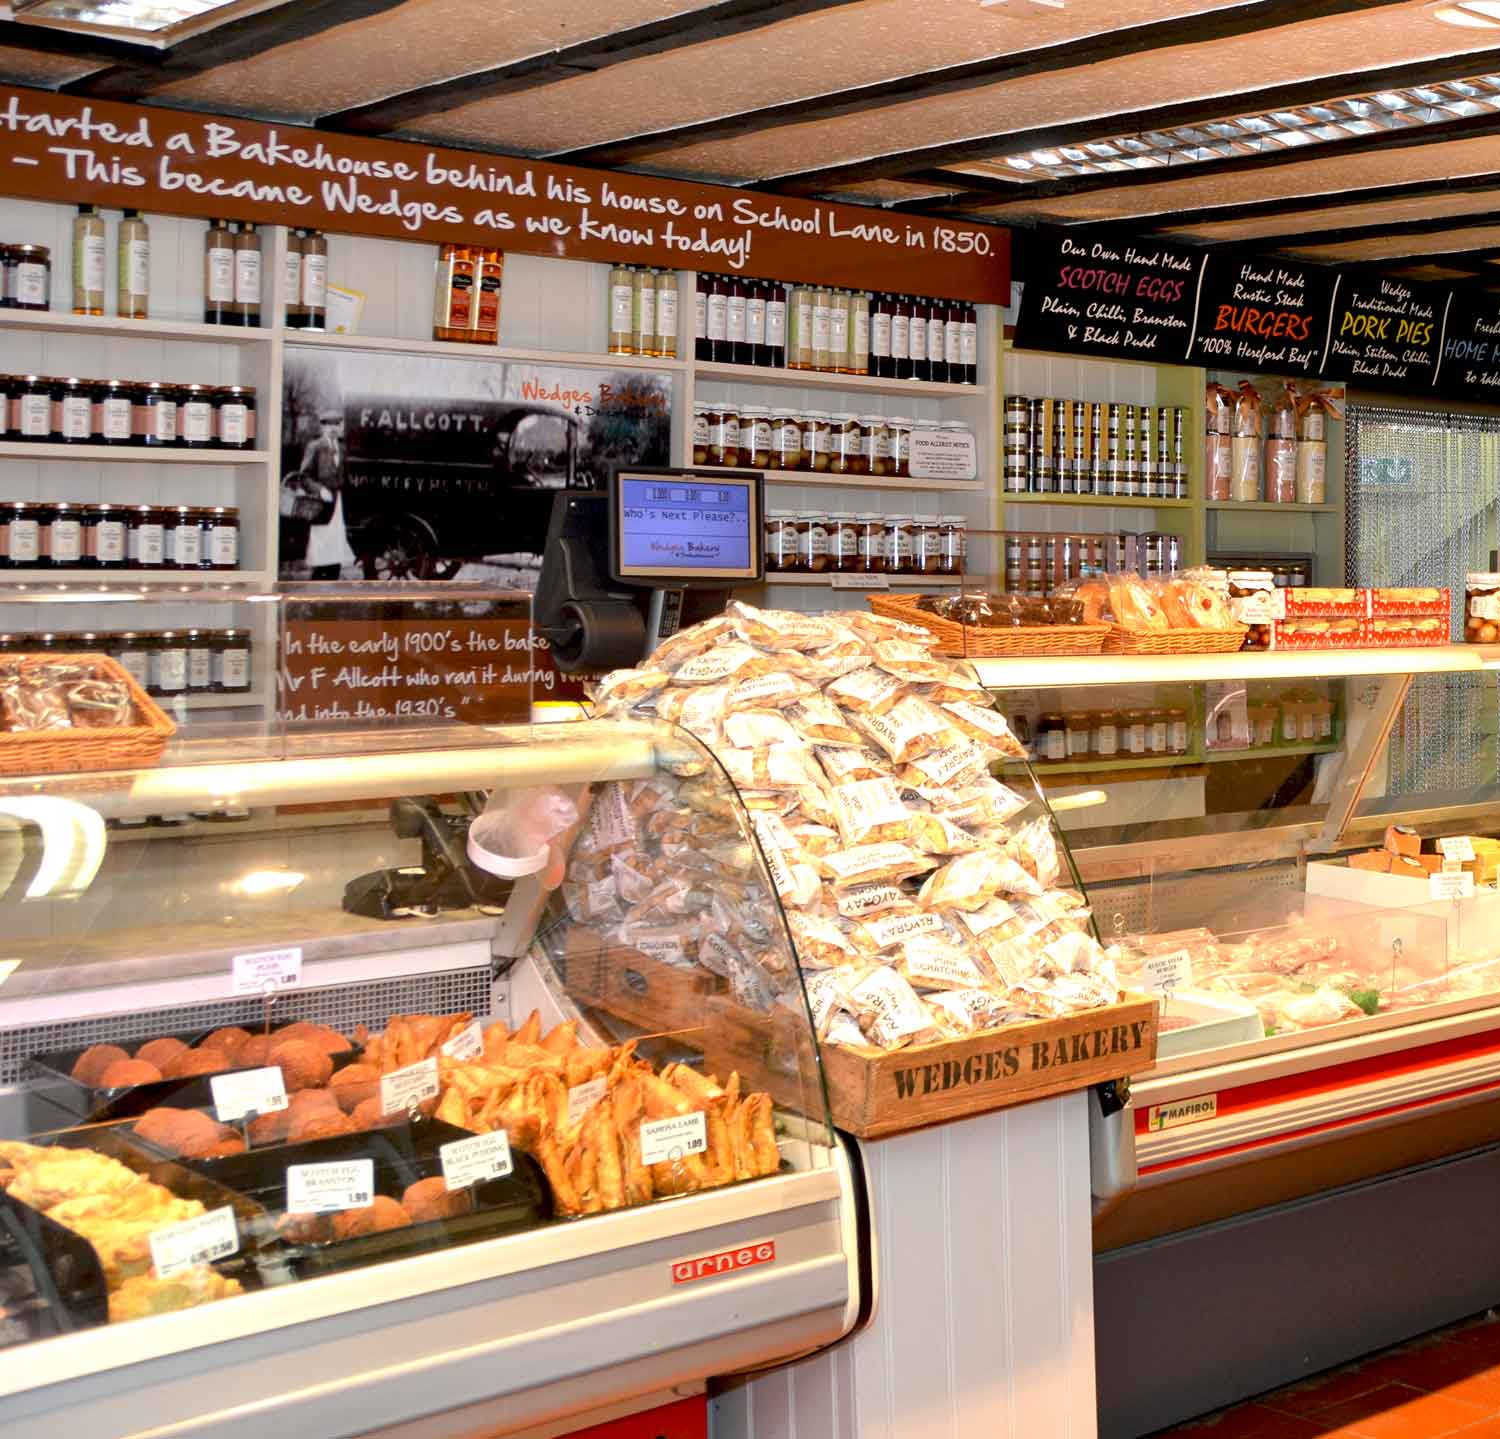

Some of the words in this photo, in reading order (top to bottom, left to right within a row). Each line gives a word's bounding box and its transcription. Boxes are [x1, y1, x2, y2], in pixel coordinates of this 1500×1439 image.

[0, 97, 153, 148] tarted
[167, 132, 194, 153] a
[204, 123, 418, 181] Bakehouse
[426, 154, 536, 197] behind
[547, 176, 591, 205] his
[601, 181, 687, 216] house
[694, 204, 723, 221] on
[733, 200, 821, 236] School
[828, 213, 900, 244] Lane
[906, 226, 925, 249] in
[932, 228, 995, 257] 1850.
[48, 147, 145, 188] This
[159, 156, 312, 206] became
[320, 174, 464, 231] Wedges
[474, 208, 516, 231] as
[526, 214, 570, 236] we
[580, 208, 654, 247] know
[660, 223, 753, 269] today!
[1061, 239, 1086, 256] Our
[1092, 244, 1119, 261] Own
[1124, 248, 1158, 266] Hand
[1161, 252, 1192, 271] Made
[1057, 266, 1130, 297] SCOTCH
[1136, 276, 1185, 304] EGGS
[1240, 264, 1274, 283] Hand
[1277, 269, 1305, 289] Made
[1233, 283, 1271, 304] Rustic
[1276, 290, 1304, 308] Steak
[1381, 280, 1411, 302] Wedges
[1133, 307, 1187, 328] Branston
[1352, 294, 1405, 315] Traditional
[1409, 302, 1432, 319] Made
[1215, 305, 1312, 342] BURGERS
[1340, 311, 1391, 341] PORK
[1396, 318, 1434, 346] PIES
[1084, 326, 1119, 345] Black
[1124, 330, 1157, 349] Pudd
[1444, 338, 1489, 362] HOME
[1237, 341, 1284, 366] Hereford
[1352, 360, 1379, 376] Black
[1383, 362, 1406, 378] Pudd
[522, 376, 592, 410] Wedges
[662, 510, 686, 521] Next
[286, 632, 302, 655] In
[307, 632, 345, 656] the
[349, 631, 399, 661] early
[404, 629, 461, 654] 1900's
[466, 630, 502, 652] the
[309, 667, 327, 690] F
[333, 667, 402, 689] Allcott
[406, 669, 439, 687] who
[445, 670, 476, 686] ran
[482, 664, 497, 685] it
[502, 666, 554, 690] during
[894, 1047, 1019, 1101] WEDGES
[1031, 1020, 1148, 1072] BAKERY
[1168, 1100, 1215, 1121] MAFIROL
[675, 1244, 772, 1281] arneg
